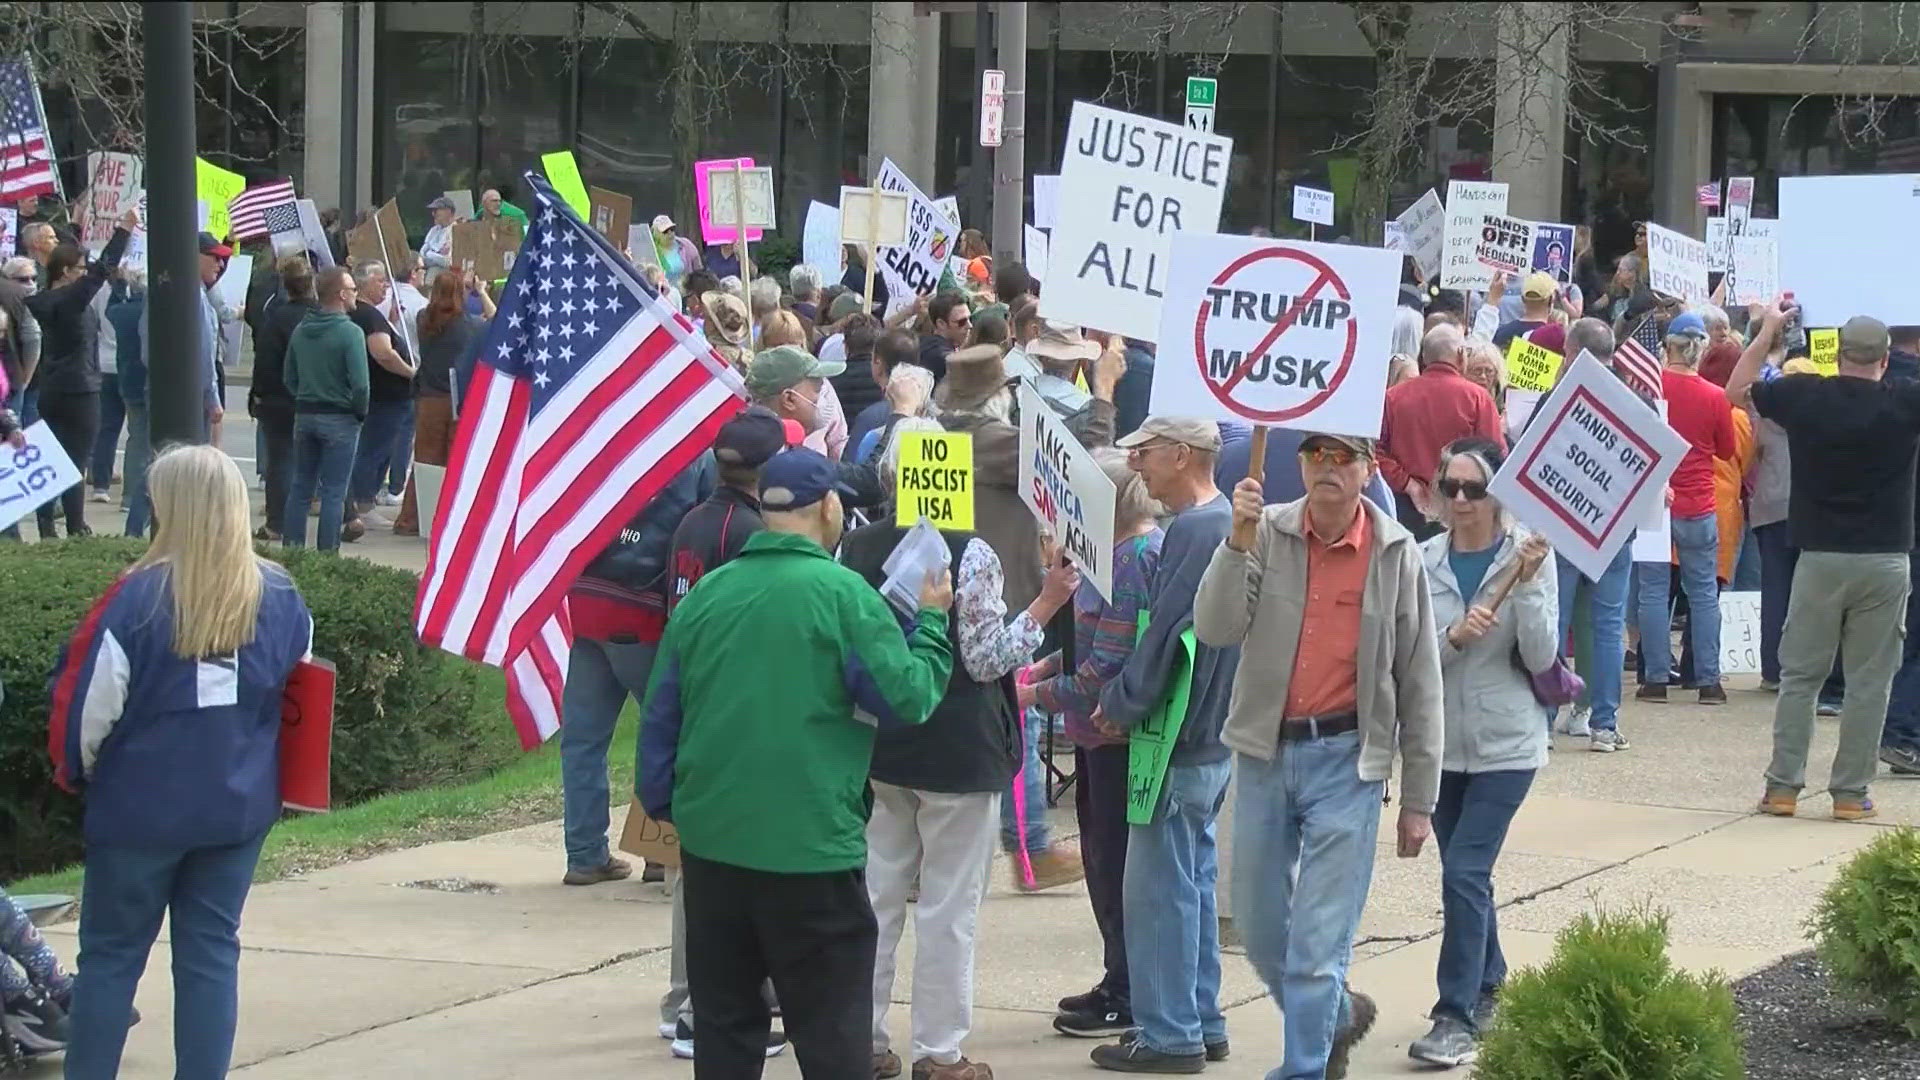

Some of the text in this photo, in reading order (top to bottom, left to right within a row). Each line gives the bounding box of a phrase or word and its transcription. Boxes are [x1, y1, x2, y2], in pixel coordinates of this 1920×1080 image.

[1078, 117, 1223, 187] JUSTICE
[1112, 185, 1182, 234] FOR
[1483, 215, 1530, 237] HANDS
[1475, 244, 1527, 268] MEDICAID
[1482, 226, 1529, 252] OFF!
[1651, 231, 1705, 265] POWER
[1076, 241, 1163, 298] ALL
[1206, 286, 1351, 330] TRUMP
[1209, 348, 1332, 391] MUSK
[1517, 352, 1551, 374] BOMBS
[1520, 366, 1540, 382] NOT
[1526, 345, 1547, 361] BAN
[921, 438, 948, 461] NO
[1035, 412, 1071, 484] MAKE
[1571, 402, 1648, 477] HANDS OFF
[902, 466, 968, 492] FASCIST
[1034, 448, 1085, 526] AMERICA
[1565, 443, 1614, 493] SOCIAL
[917, 496, 953, 521] USA
[1538, 463, 1605, 526] SECURITY
[1065, 521, 1098, 576] AGAIN
